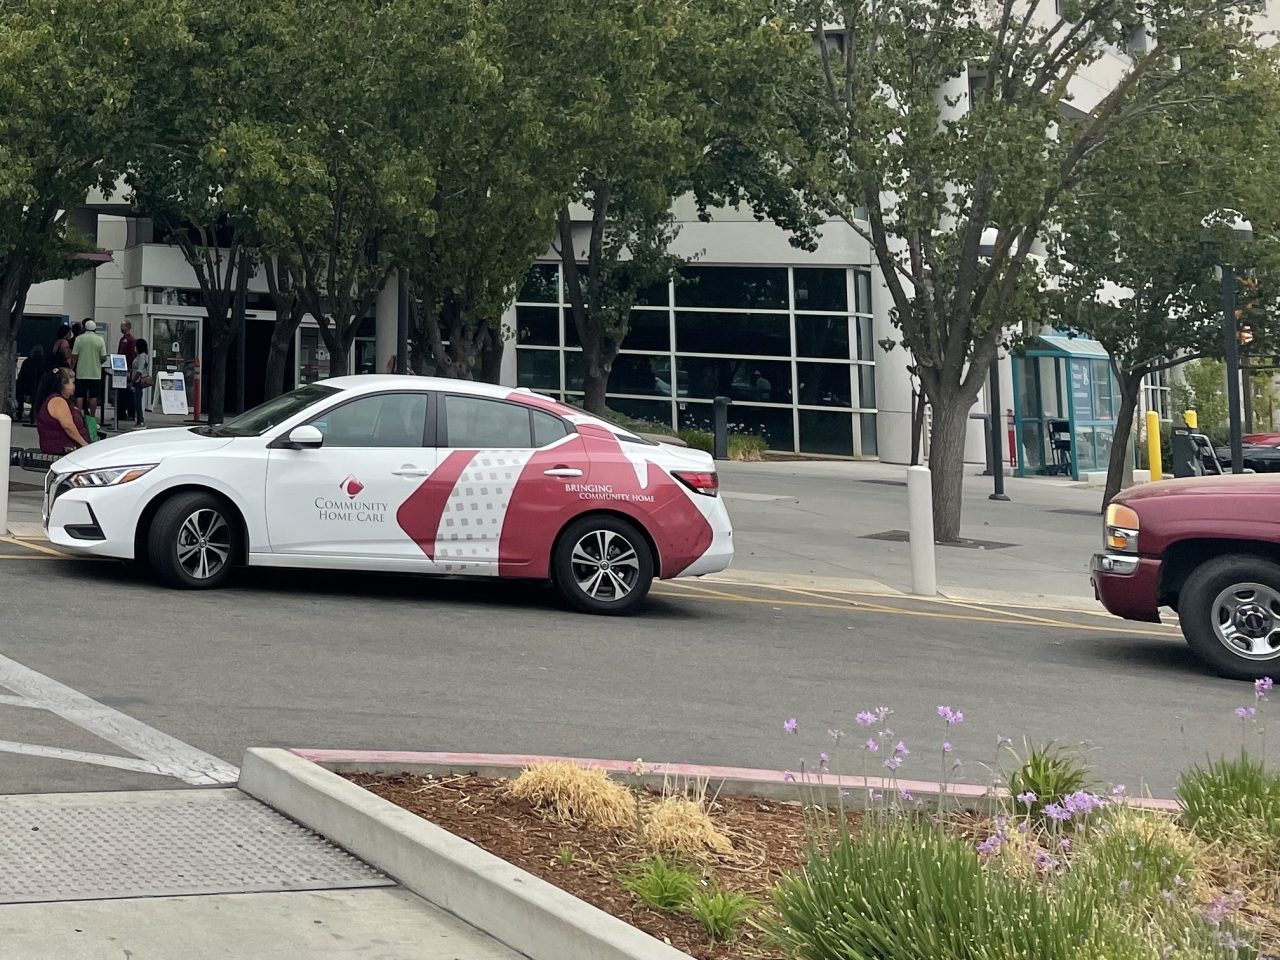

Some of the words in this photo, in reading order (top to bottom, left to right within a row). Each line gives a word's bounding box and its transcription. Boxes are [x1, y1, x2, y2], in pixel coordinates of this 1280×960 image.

[565, 483, 613, 493] BRINGING
[579, 492, 630, 501] COMMUNITY
[632, 494, 655, 503] HOME
[314, 496, 388, 512] COMMUNITY
[319, 510, 353, 521] HOME
[356, 511, 385, 523] CARE
